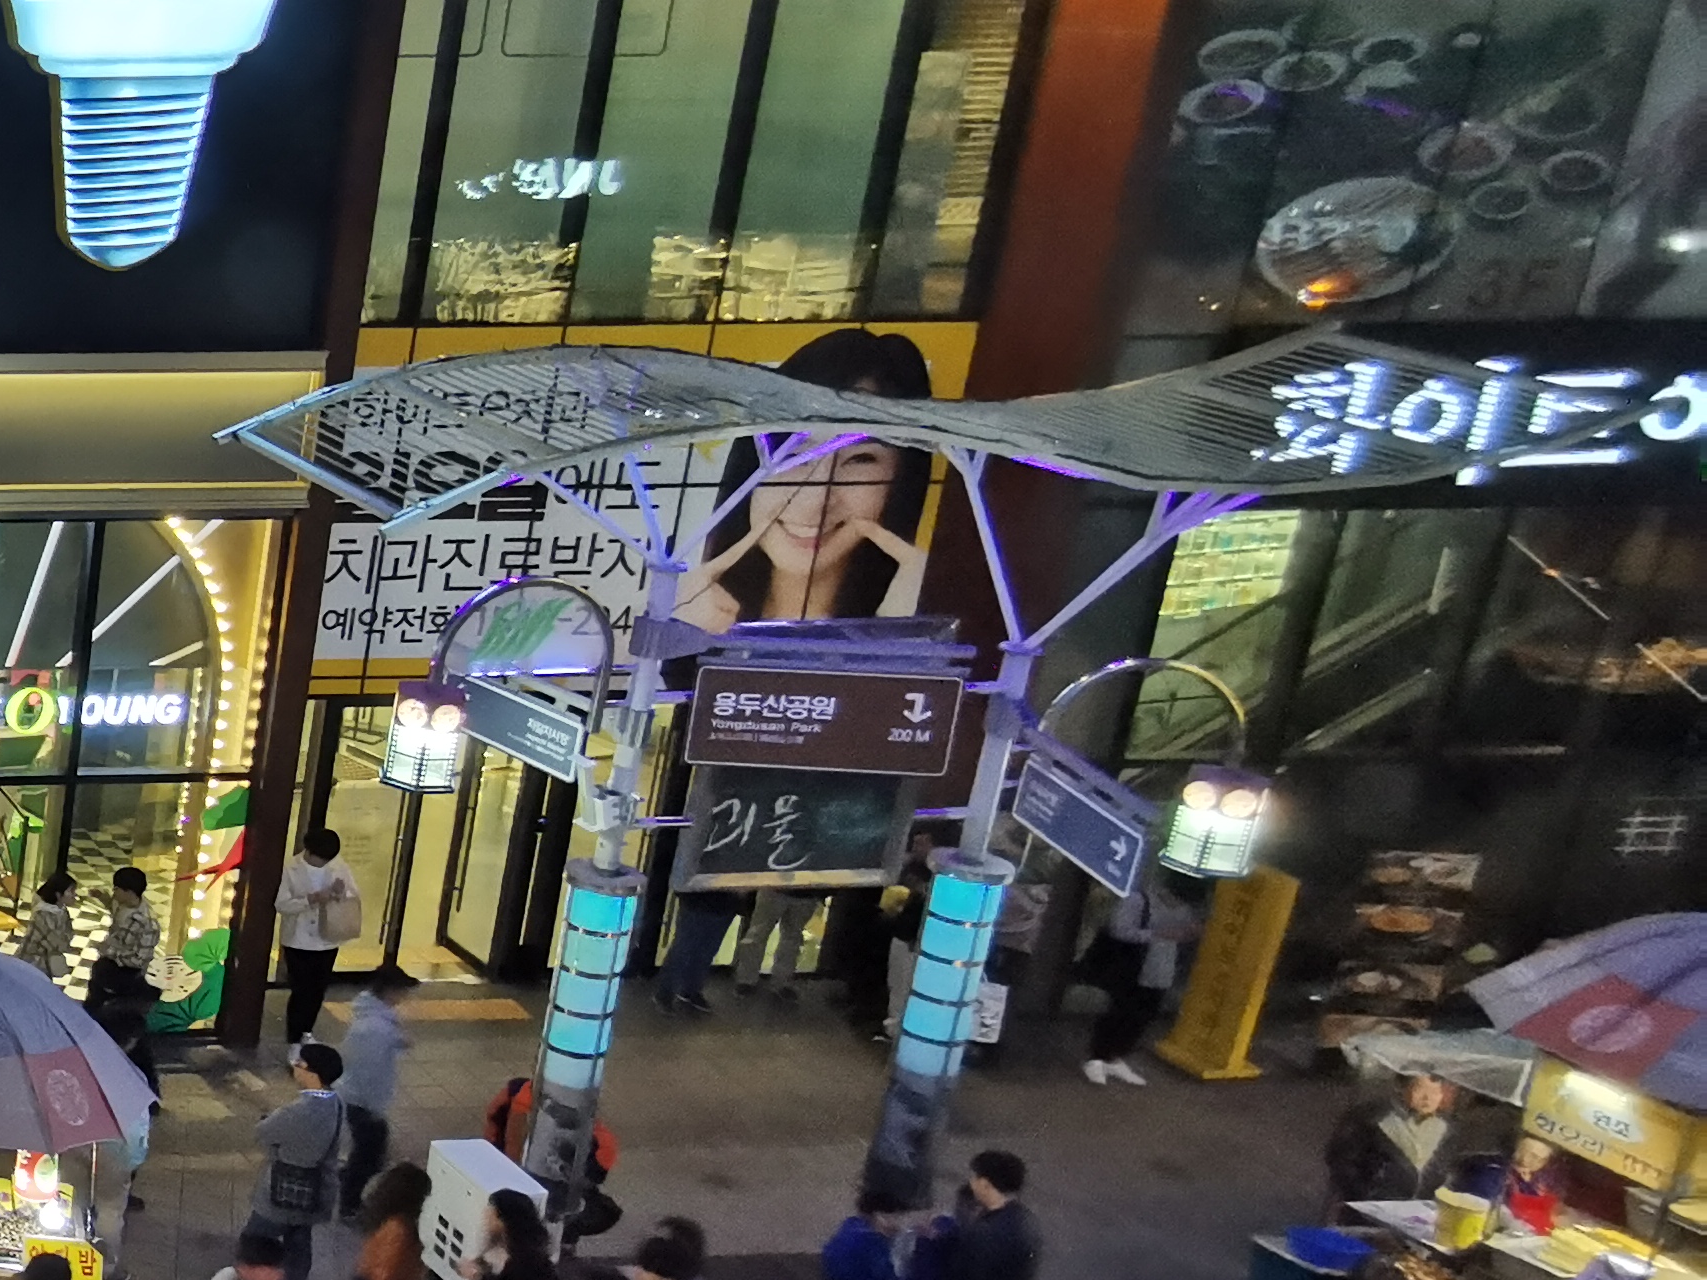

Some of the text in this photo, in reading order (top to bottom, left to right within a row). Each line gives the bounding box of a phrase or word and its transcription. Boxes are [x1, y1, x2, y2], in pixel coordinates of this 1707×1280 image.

[321, 604, 460, 645] 예약전화
[712, 691, 838, 722] 용두산공원
[789, 720, 823, 735] Park
